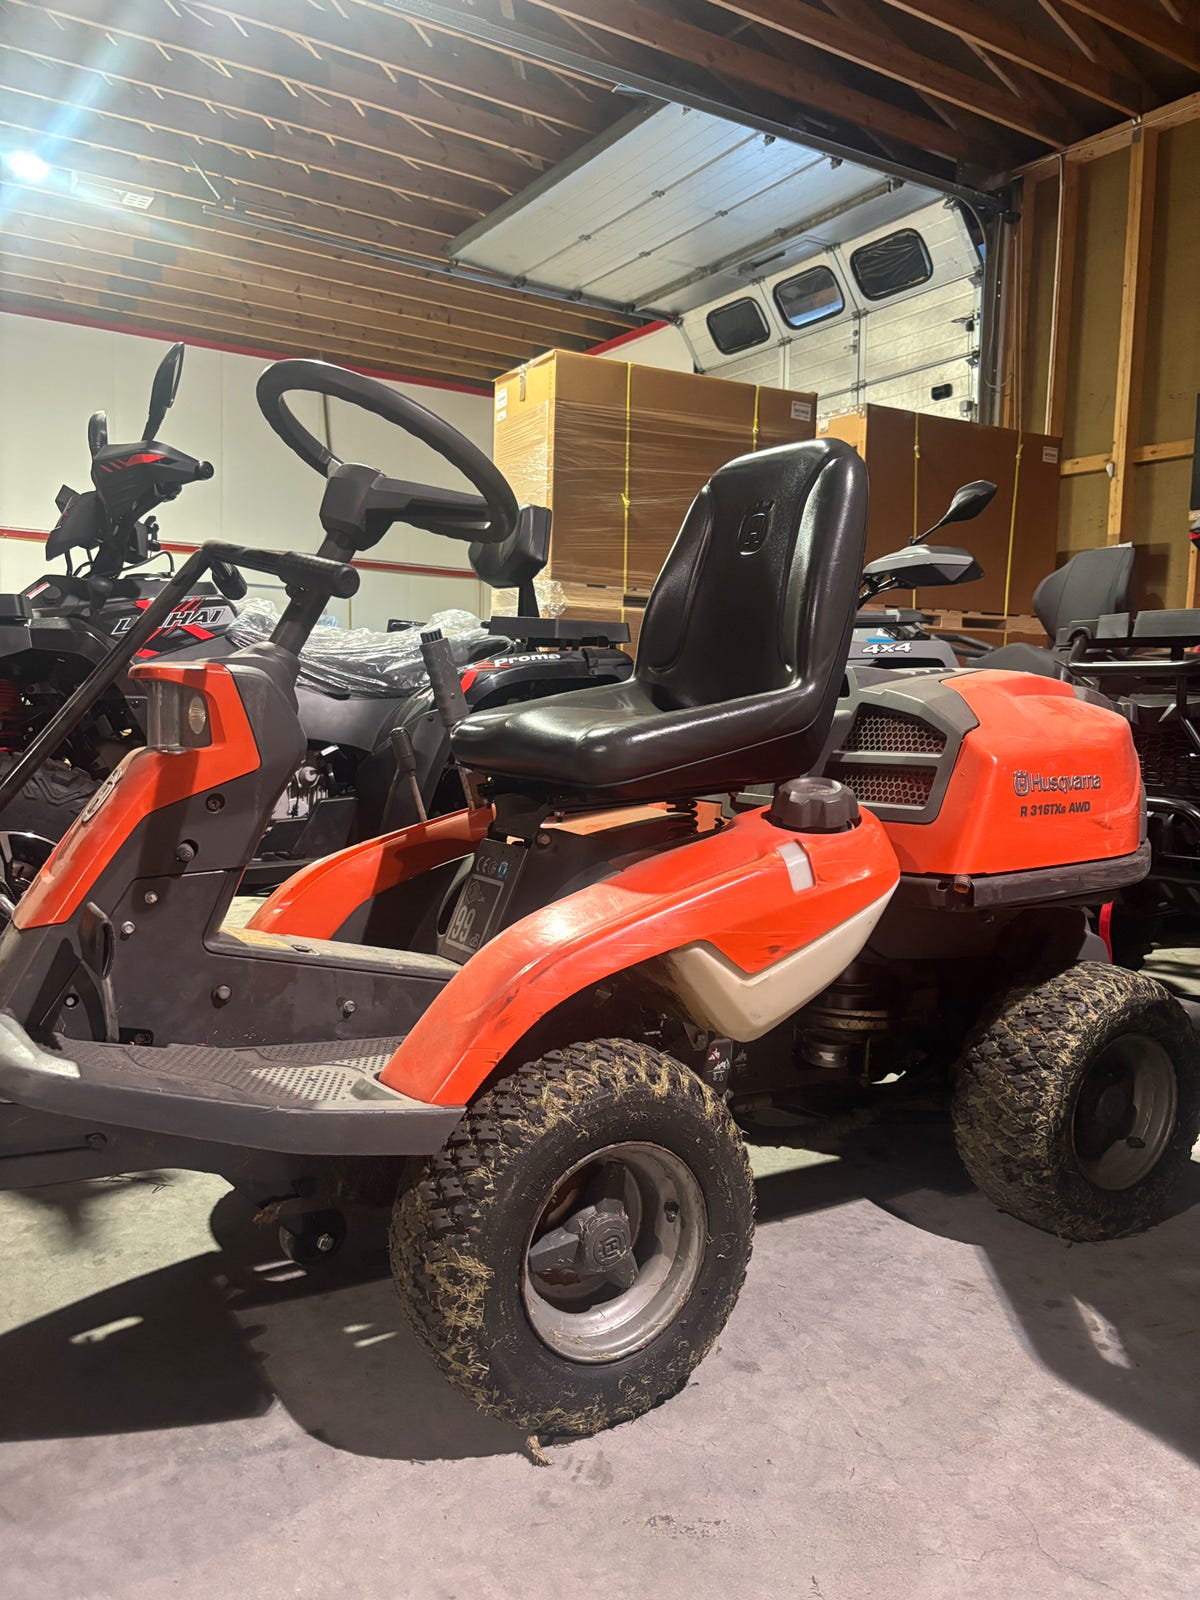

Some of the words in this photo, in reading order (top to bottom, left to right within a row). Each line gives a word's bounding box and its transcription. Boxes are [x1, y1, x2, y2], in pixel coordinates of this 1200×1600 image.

[110, 608, 225, 635] LHAI
[1030, 773, 1101, 793] Husqvarna
[1020, 806, 1028, 817] R
[1068, 801, 1091, 813] AWD
[451, 905, 476, 941] 99
